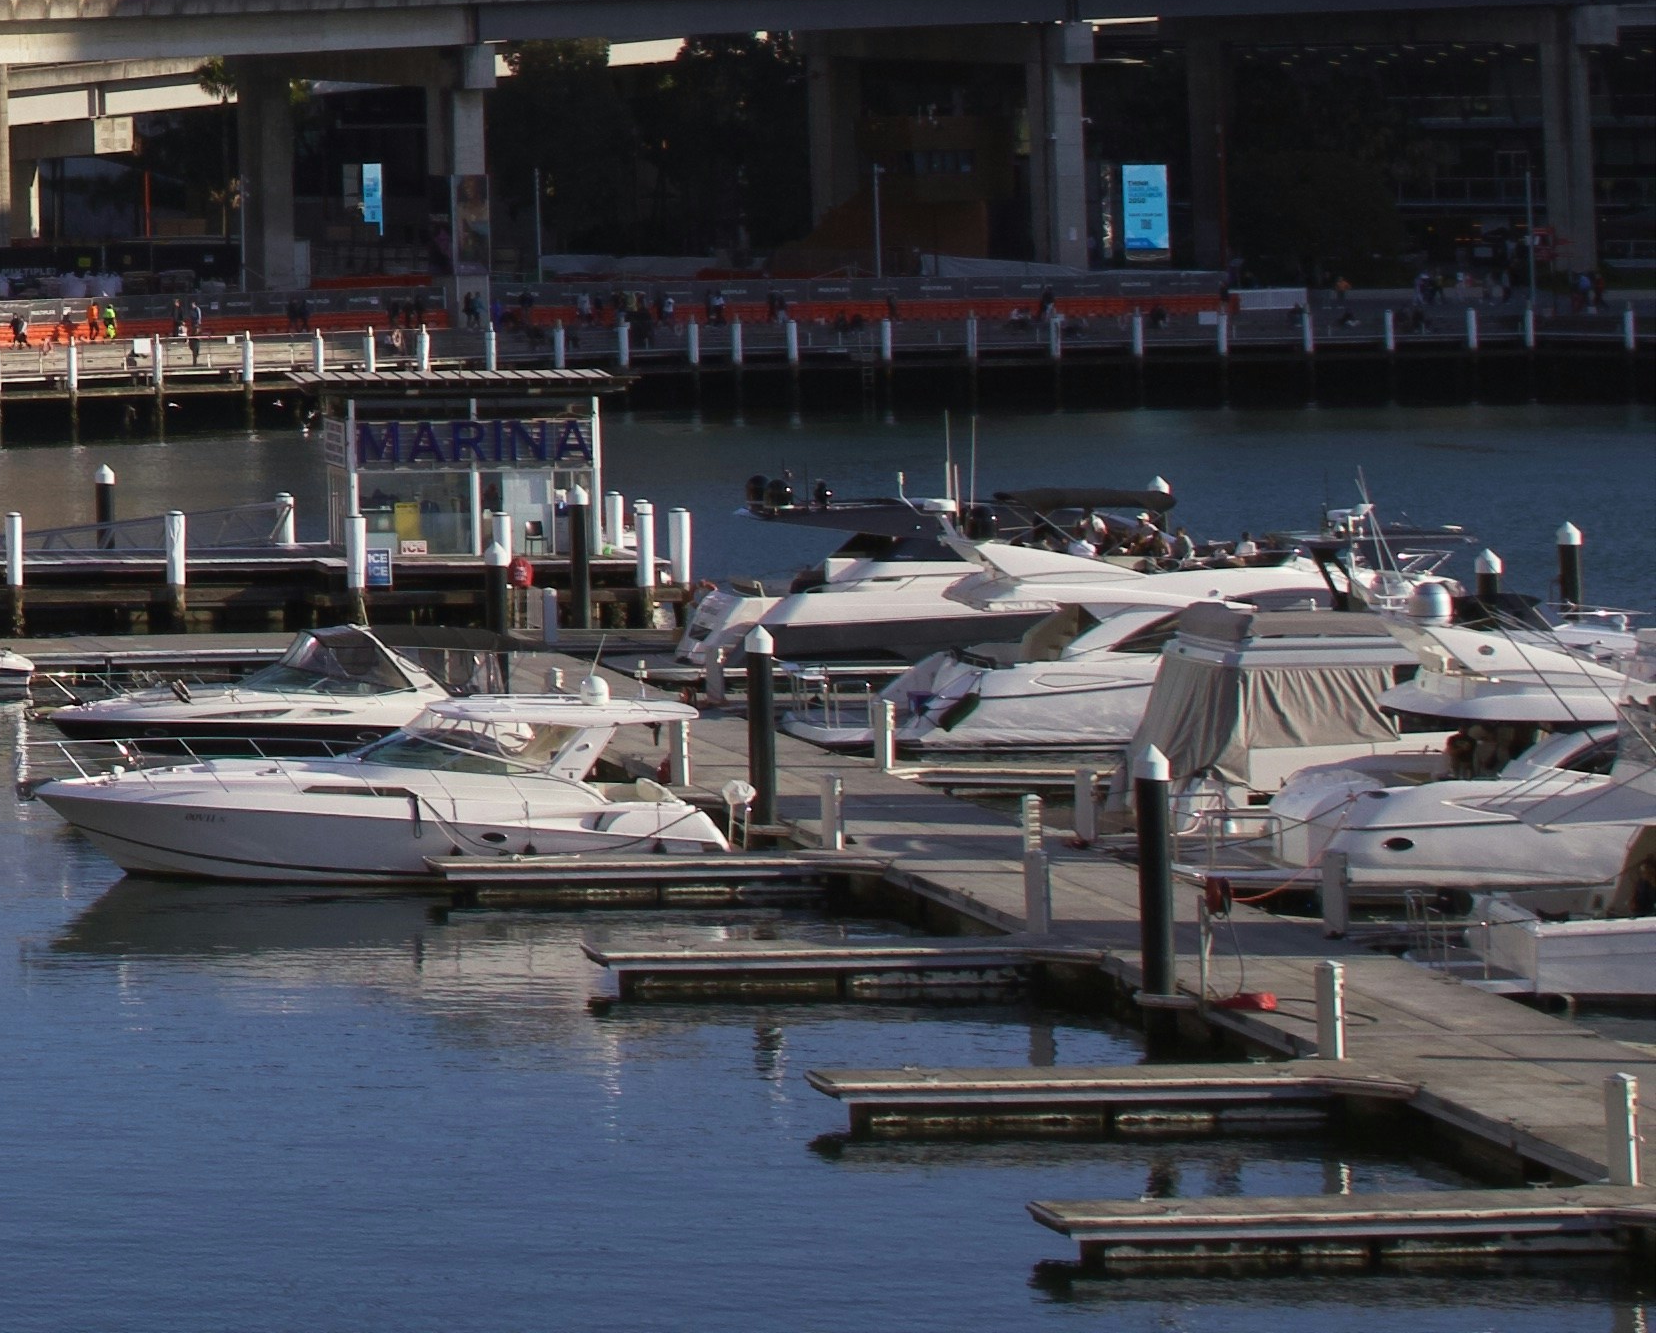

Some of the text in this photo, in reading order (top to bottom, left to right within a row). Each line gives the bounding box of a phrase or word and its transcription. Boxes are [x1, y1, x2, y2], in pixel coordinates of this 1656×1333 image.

[356, 419, 593, 463] MARINA
[402, 543, 426, 553] ICE
[368, 553, 388, 563] ICE
[368, 566, 388, 576] ICE
